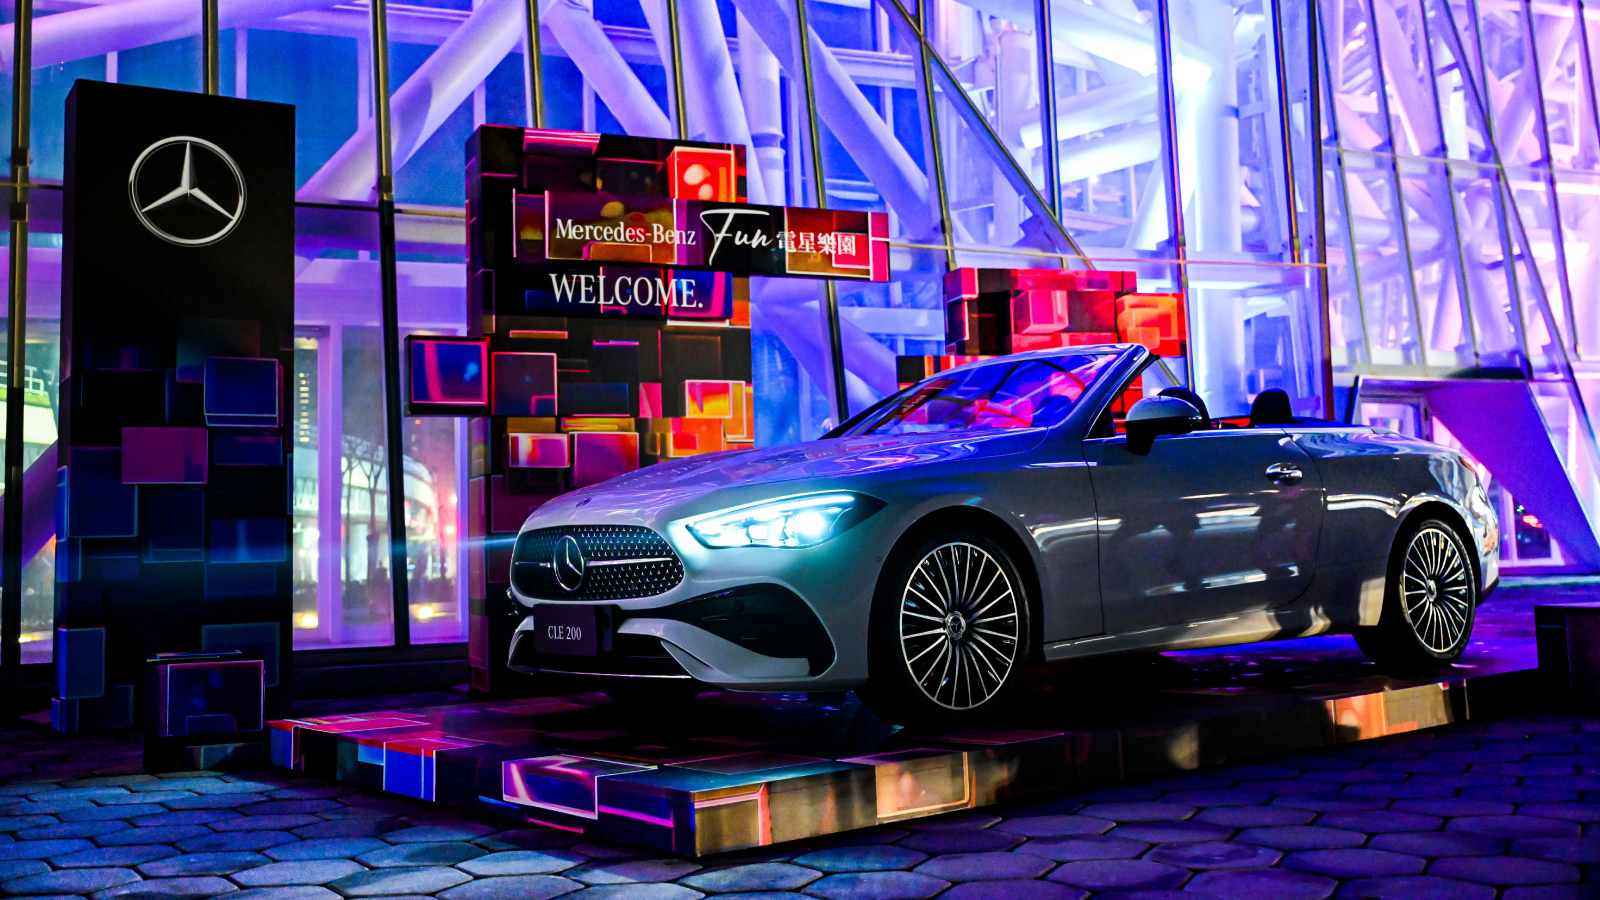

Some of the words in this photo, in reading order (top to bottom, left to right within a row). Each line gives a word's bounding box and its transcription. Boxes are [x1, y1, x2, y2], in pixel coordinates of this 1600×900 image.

[555, 218, 696, 246] Mercedes-Benz
[700, 208, 773, 266] Fun
[776, 231, 856, 256] 電星樂園
[549, 273, 704, 309] WELCOME.
[547, 625, 564, 640] CLE
[565, 626, 582, 641] 200
